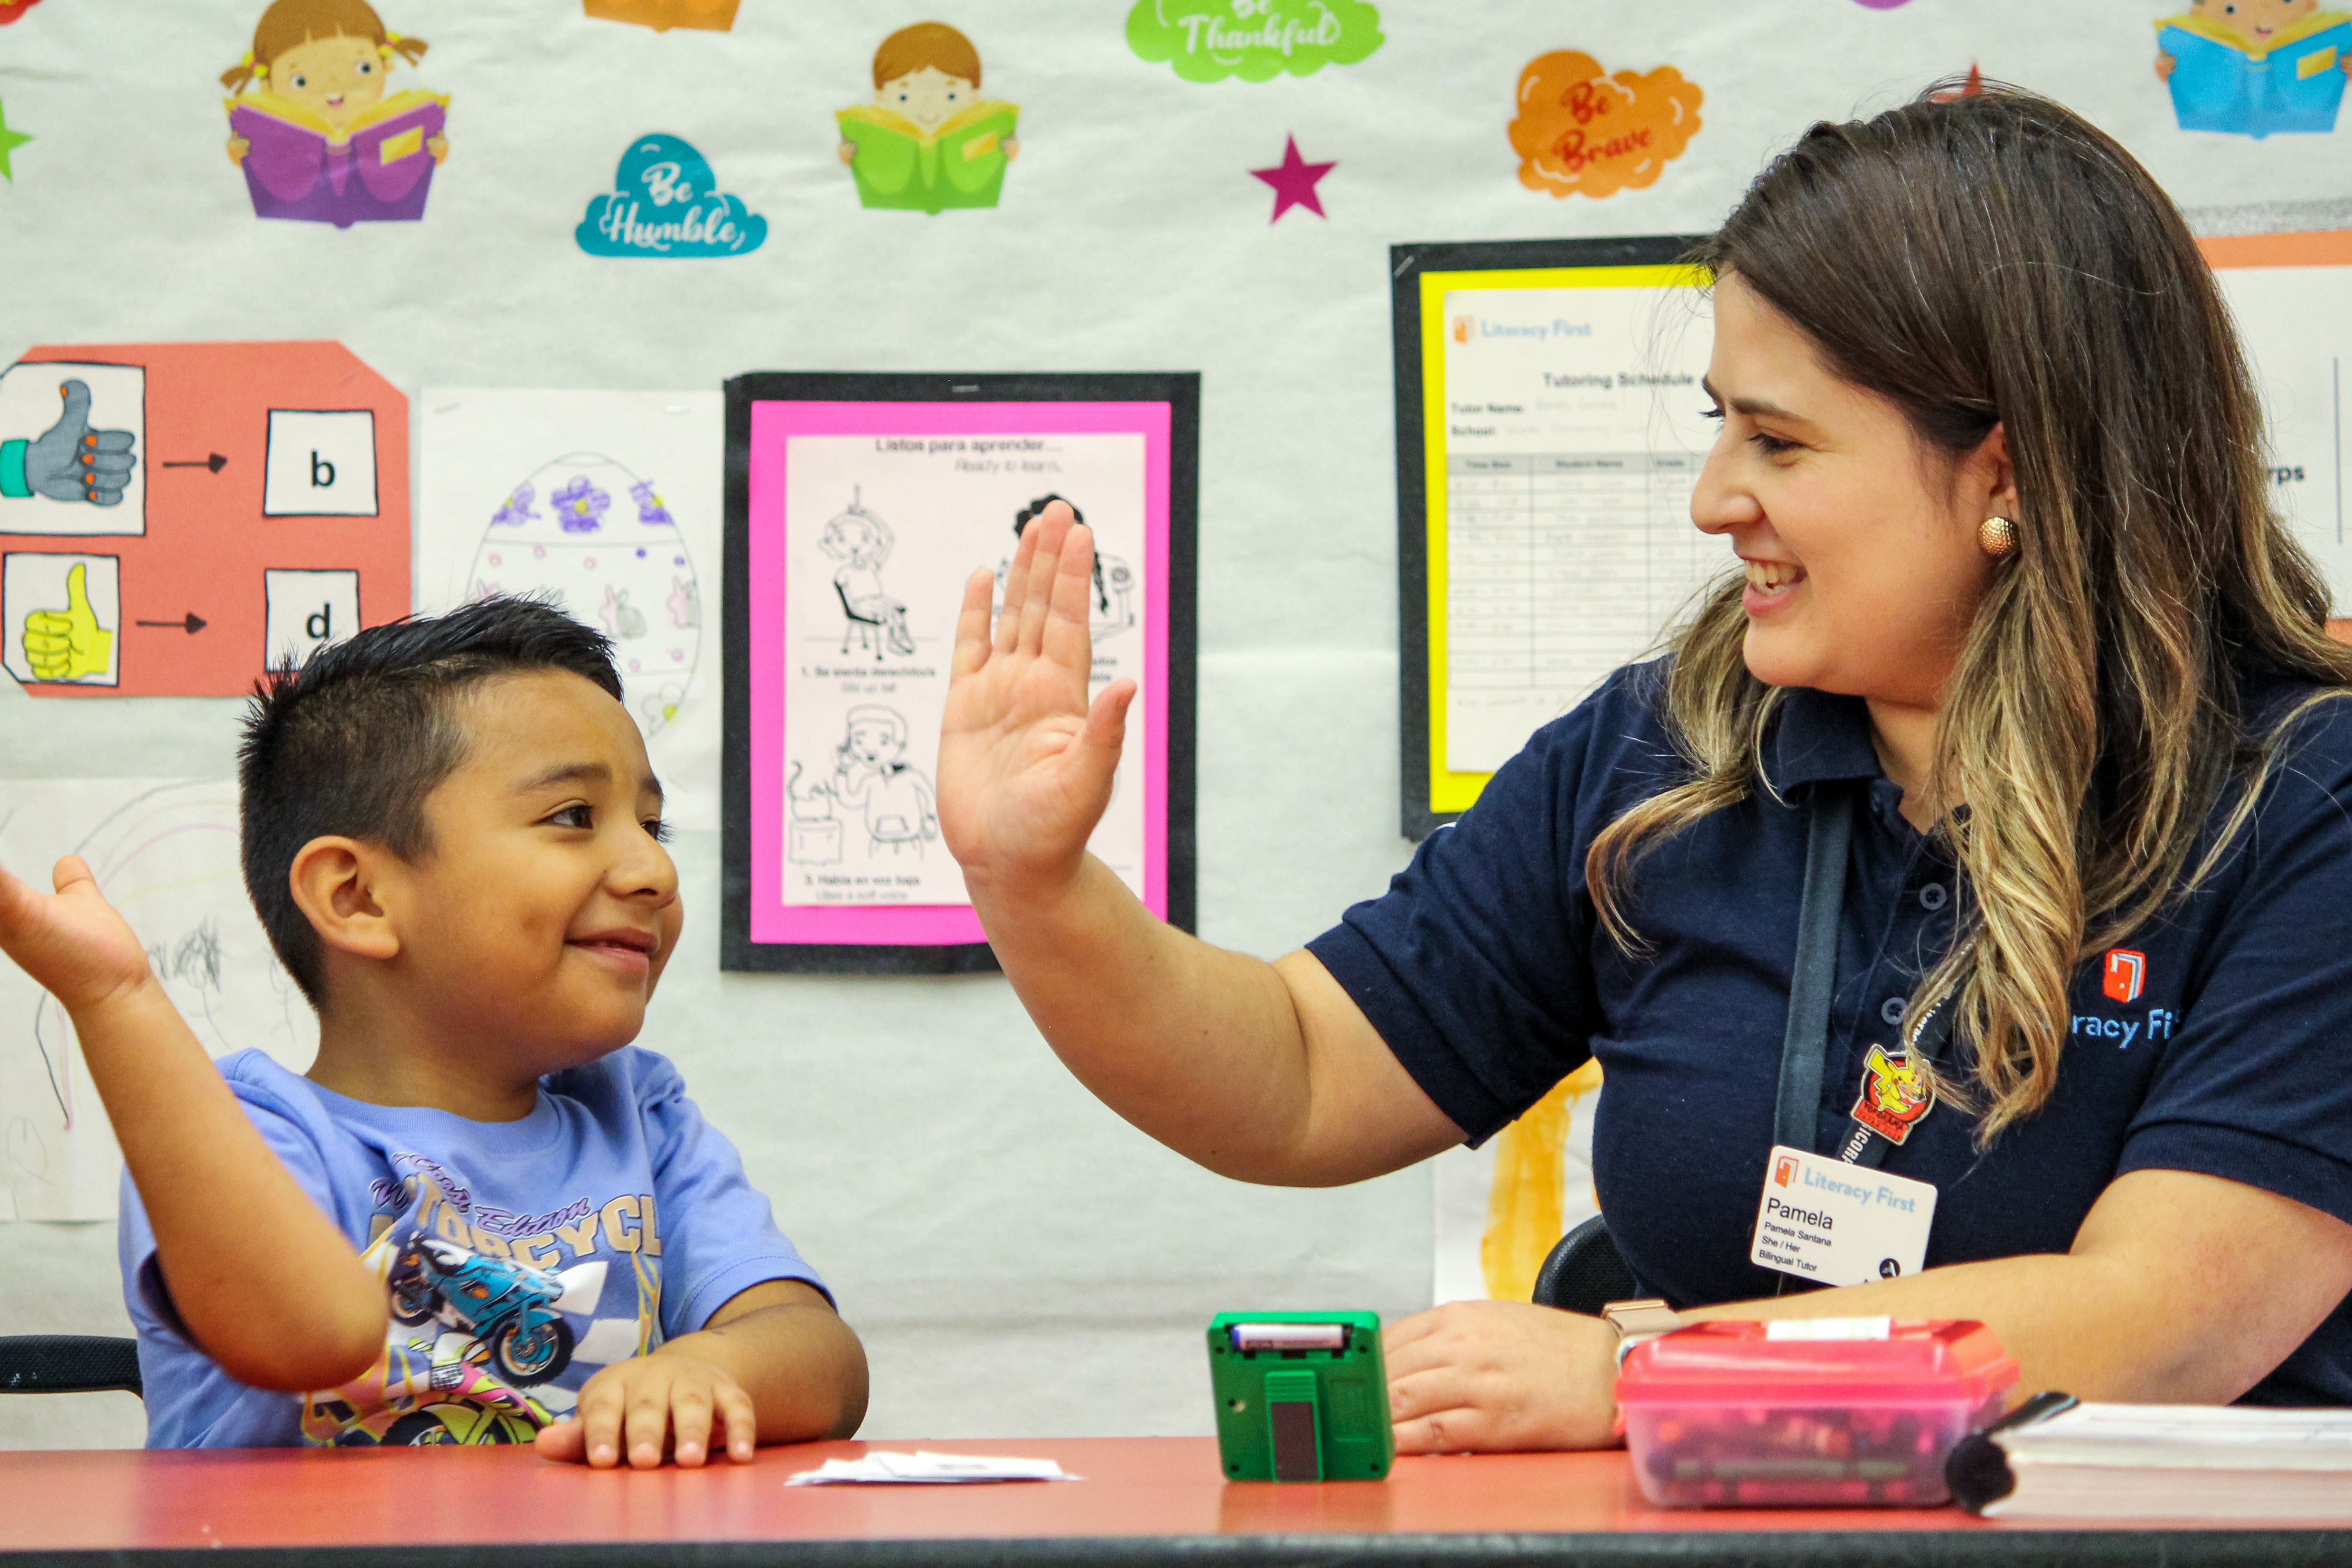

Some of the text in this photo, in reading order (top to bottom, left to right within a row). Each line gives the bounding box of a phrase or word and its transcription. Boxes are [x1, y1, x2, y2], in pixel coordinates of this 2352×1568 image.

[1177, 11, 1341, 56] Thankful
[1560, 81, 1612, 124] Be
[1552, 129, 1650, 172] Brave
[641, 161, 693, 207] Be
[1481, 319, 1591, 341] Literacy First
[1543, 372, 1694, 390] Tutoring Schedule
[876, 439, 924, 452] Listos
[929, 440, 966, 455] para
[310, 451, 335, 487] b
[306, 603, 330, 638] d
[1804, 1167, 1915, 1213] Literacy First
[474, 1196, 591, 1237] Edition
[1767, 1197, 1834, 1230] Pamela
[1762, 1236, 1778, 1247] She
[1785, 1242, 1801, 1252] Her
[1764, 1221, 1832, 1247] Pamela Santana
[1759, 1249, 1818, 1272] Bilingual Tutor
